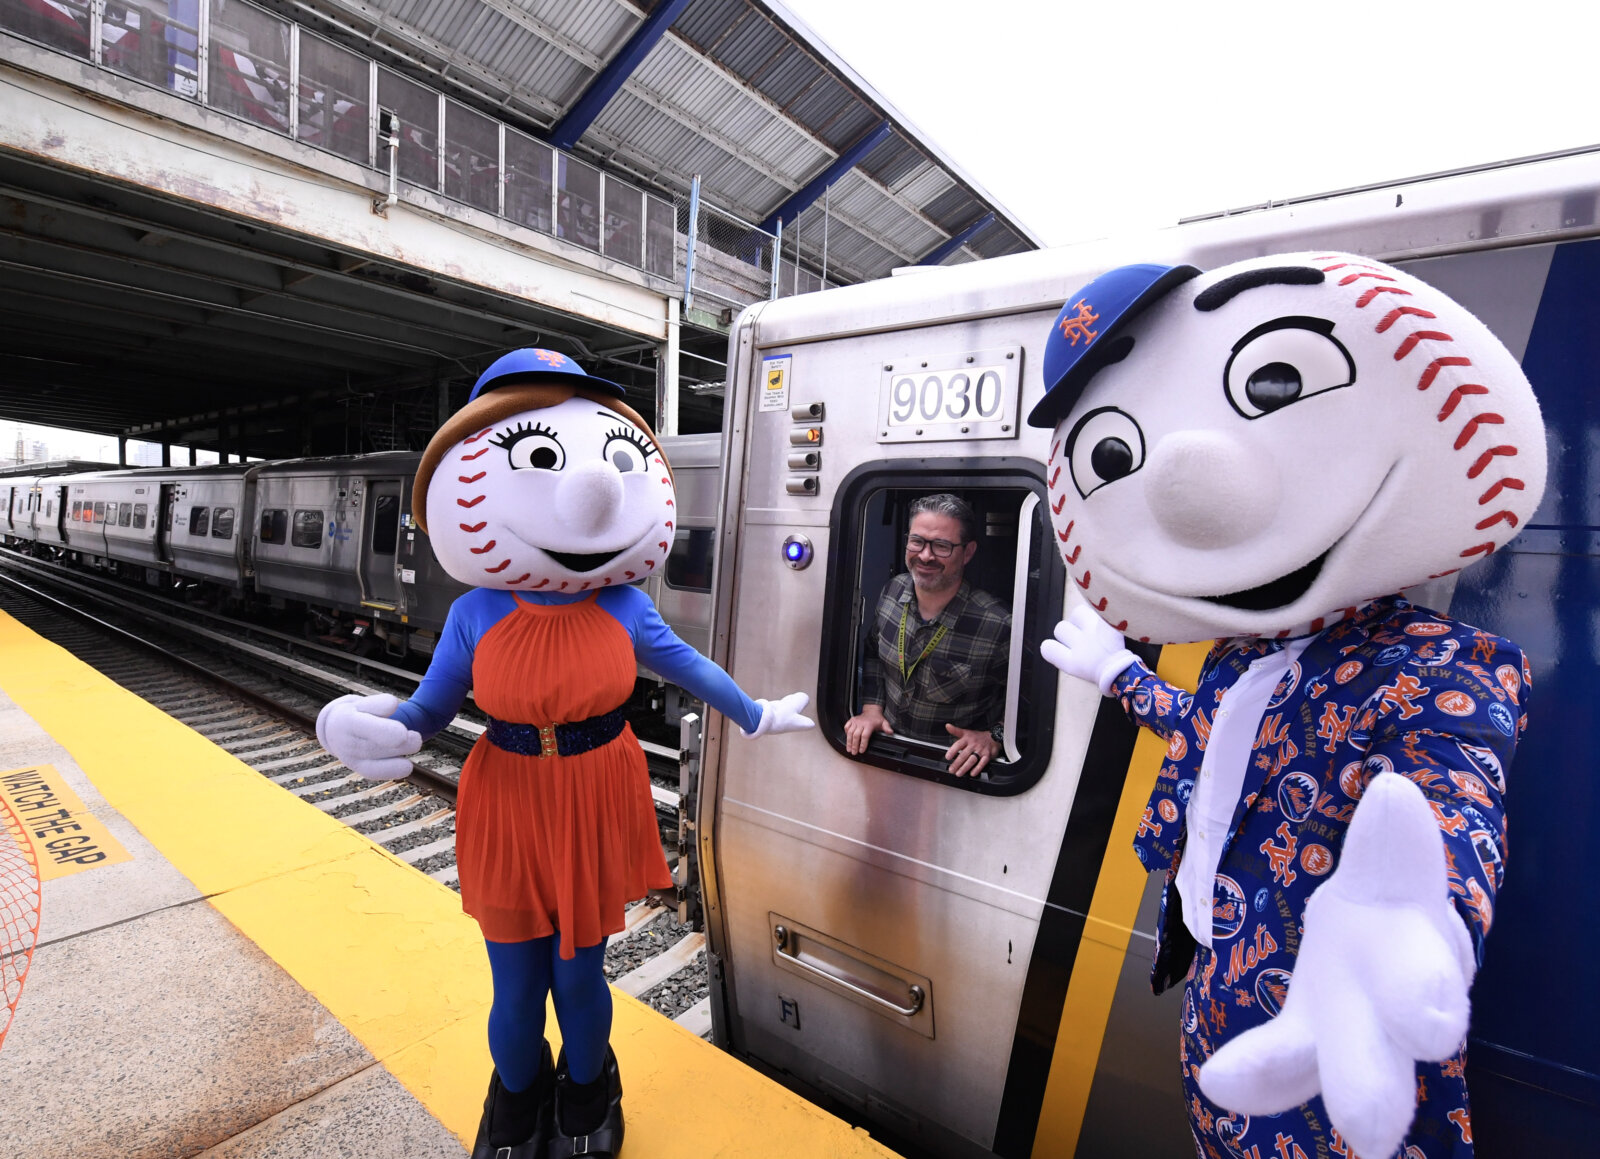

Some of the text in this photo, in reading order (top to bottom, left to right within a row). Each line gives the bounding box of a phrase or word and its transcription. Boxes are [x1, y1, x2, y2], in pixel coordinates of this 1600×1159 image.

[1059, 298, 1100, 347] NY
[893, 370, 1002, 422] 9030
[1418, 667, 1490, 700] NEW YORK
[1455, 661, 1508, 702] Mets
[1304, 725, 1317, 758] YORK
[1316, 701, 1357, 753] NY
[1159, 764, 1179, 780] ets
[0, 769, 107, 865] WATCH THE GAP
[1285, 784, 1307, 814] Mets
[1151, 841, 1172, 860] NEW
[1275, 889, 1299, 956] NEW YORK
[1223, 922, 1278, 986] Mets
[1313, 1134, 1330, 1159] YOR
